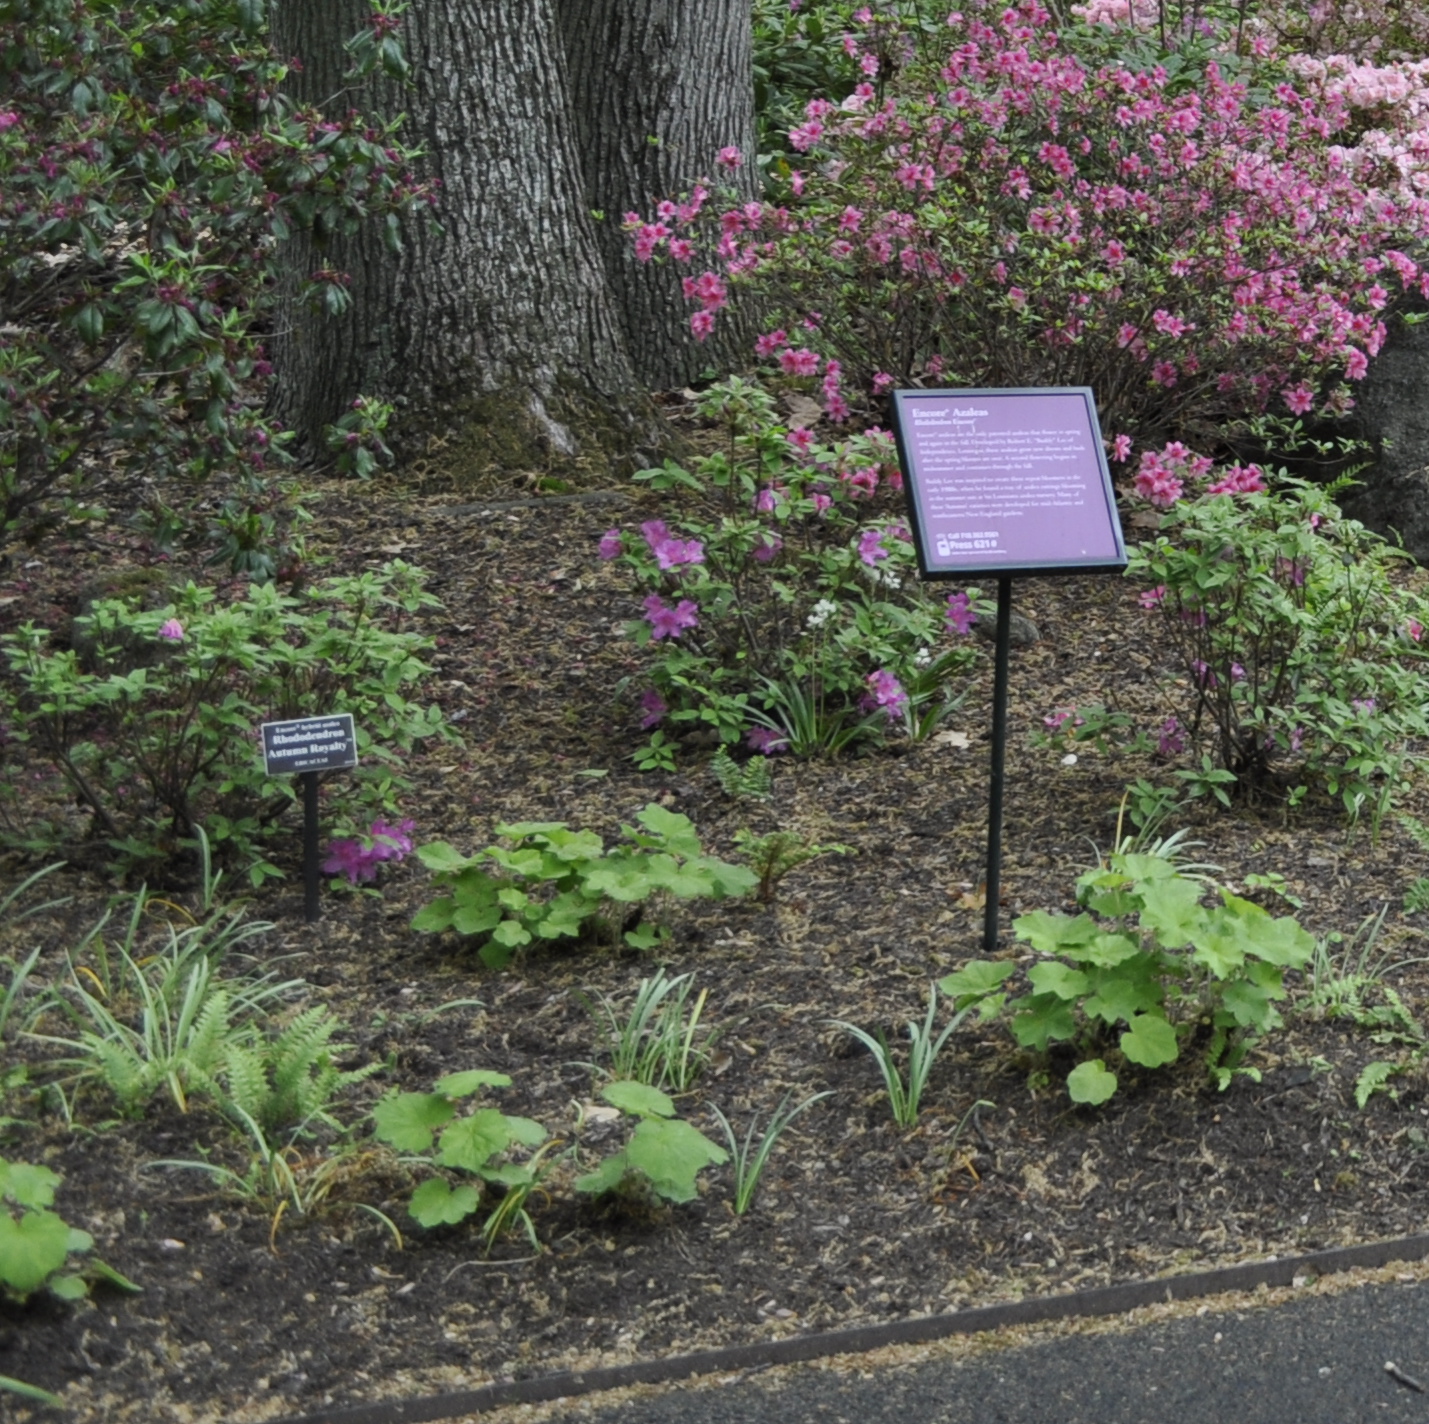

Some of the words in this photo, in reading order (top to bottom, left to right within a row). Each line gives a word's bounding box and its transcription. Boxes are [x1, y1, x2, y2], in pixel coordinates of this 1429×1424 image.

[949, 541, 973, 549] Press
[273, 729, 345, 745] Rhododendron
[268, 747, 308, 759] Autumn
